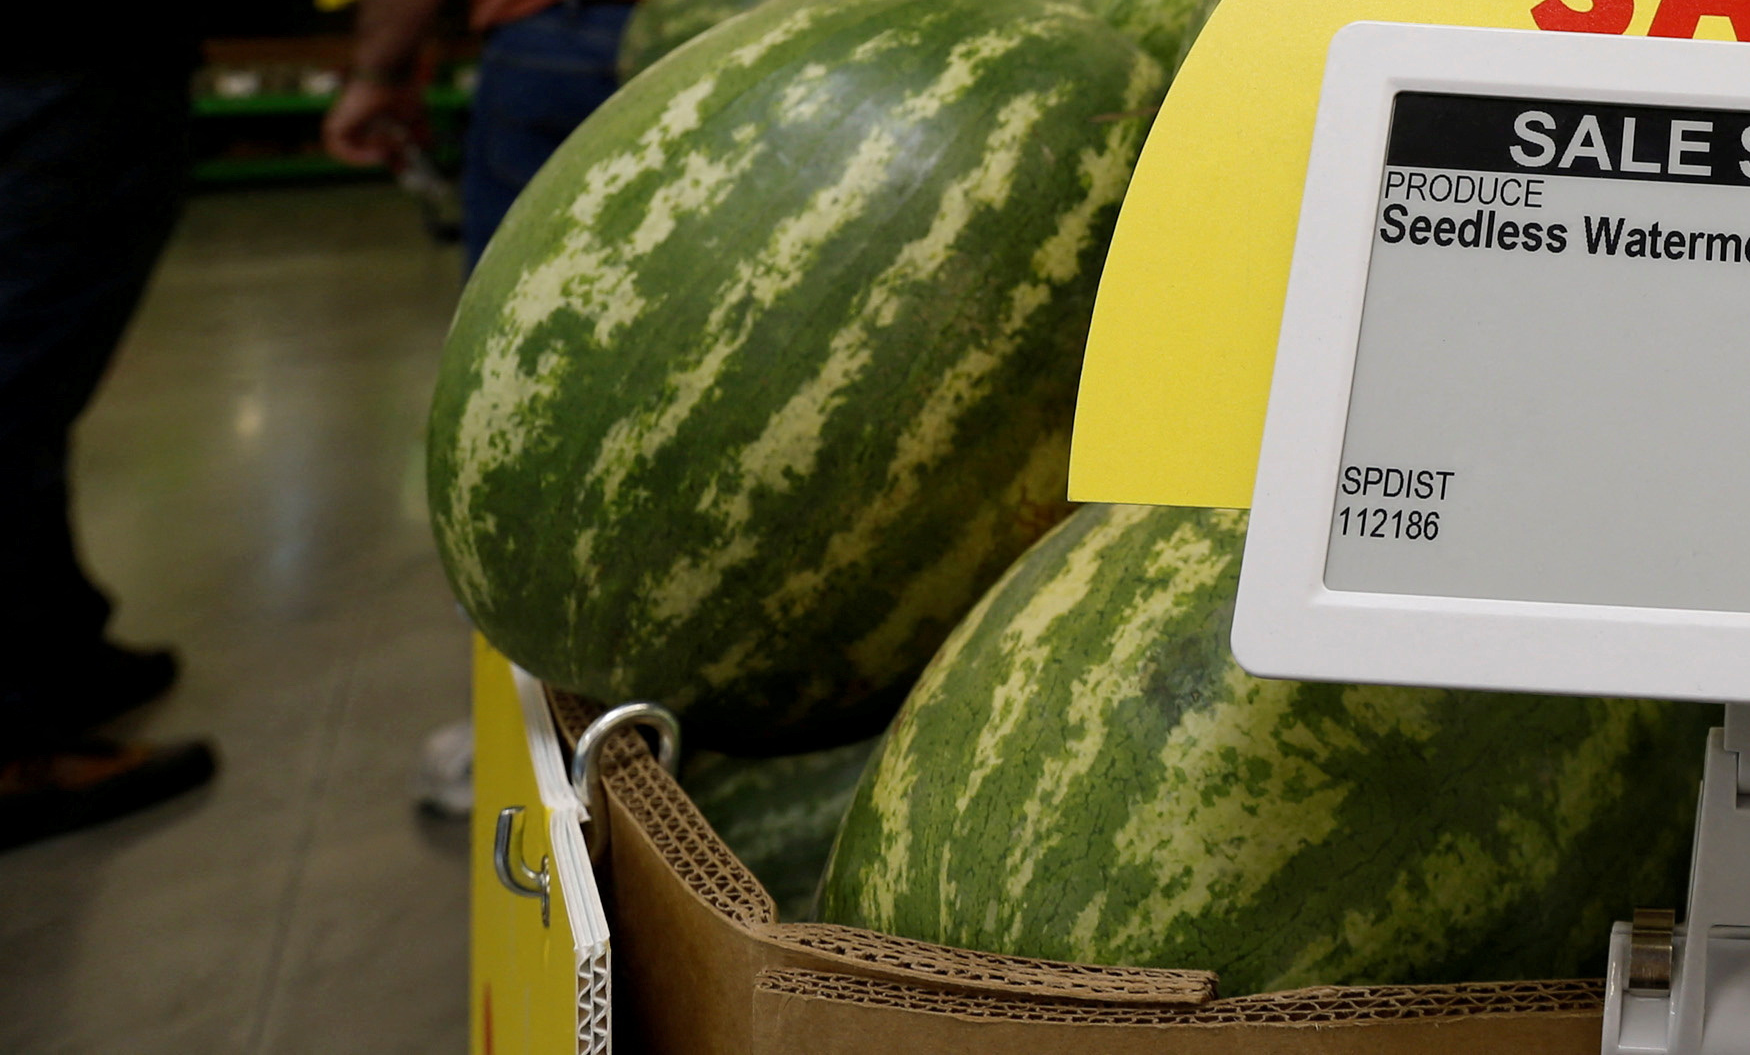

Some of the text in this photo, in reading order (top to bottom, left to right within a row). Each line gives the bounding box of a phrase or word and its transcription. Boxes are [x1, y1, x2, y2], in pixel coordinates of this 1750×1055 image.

[1510, 110, 1714, 177] SALE
[1384, 172, 1545, 208] PRODUCE
[1380, 203, 1569, 254] Seedless
[1341, 465, 1456, 501] SPDIST
[1338, 506, 1441, 542] 112186
